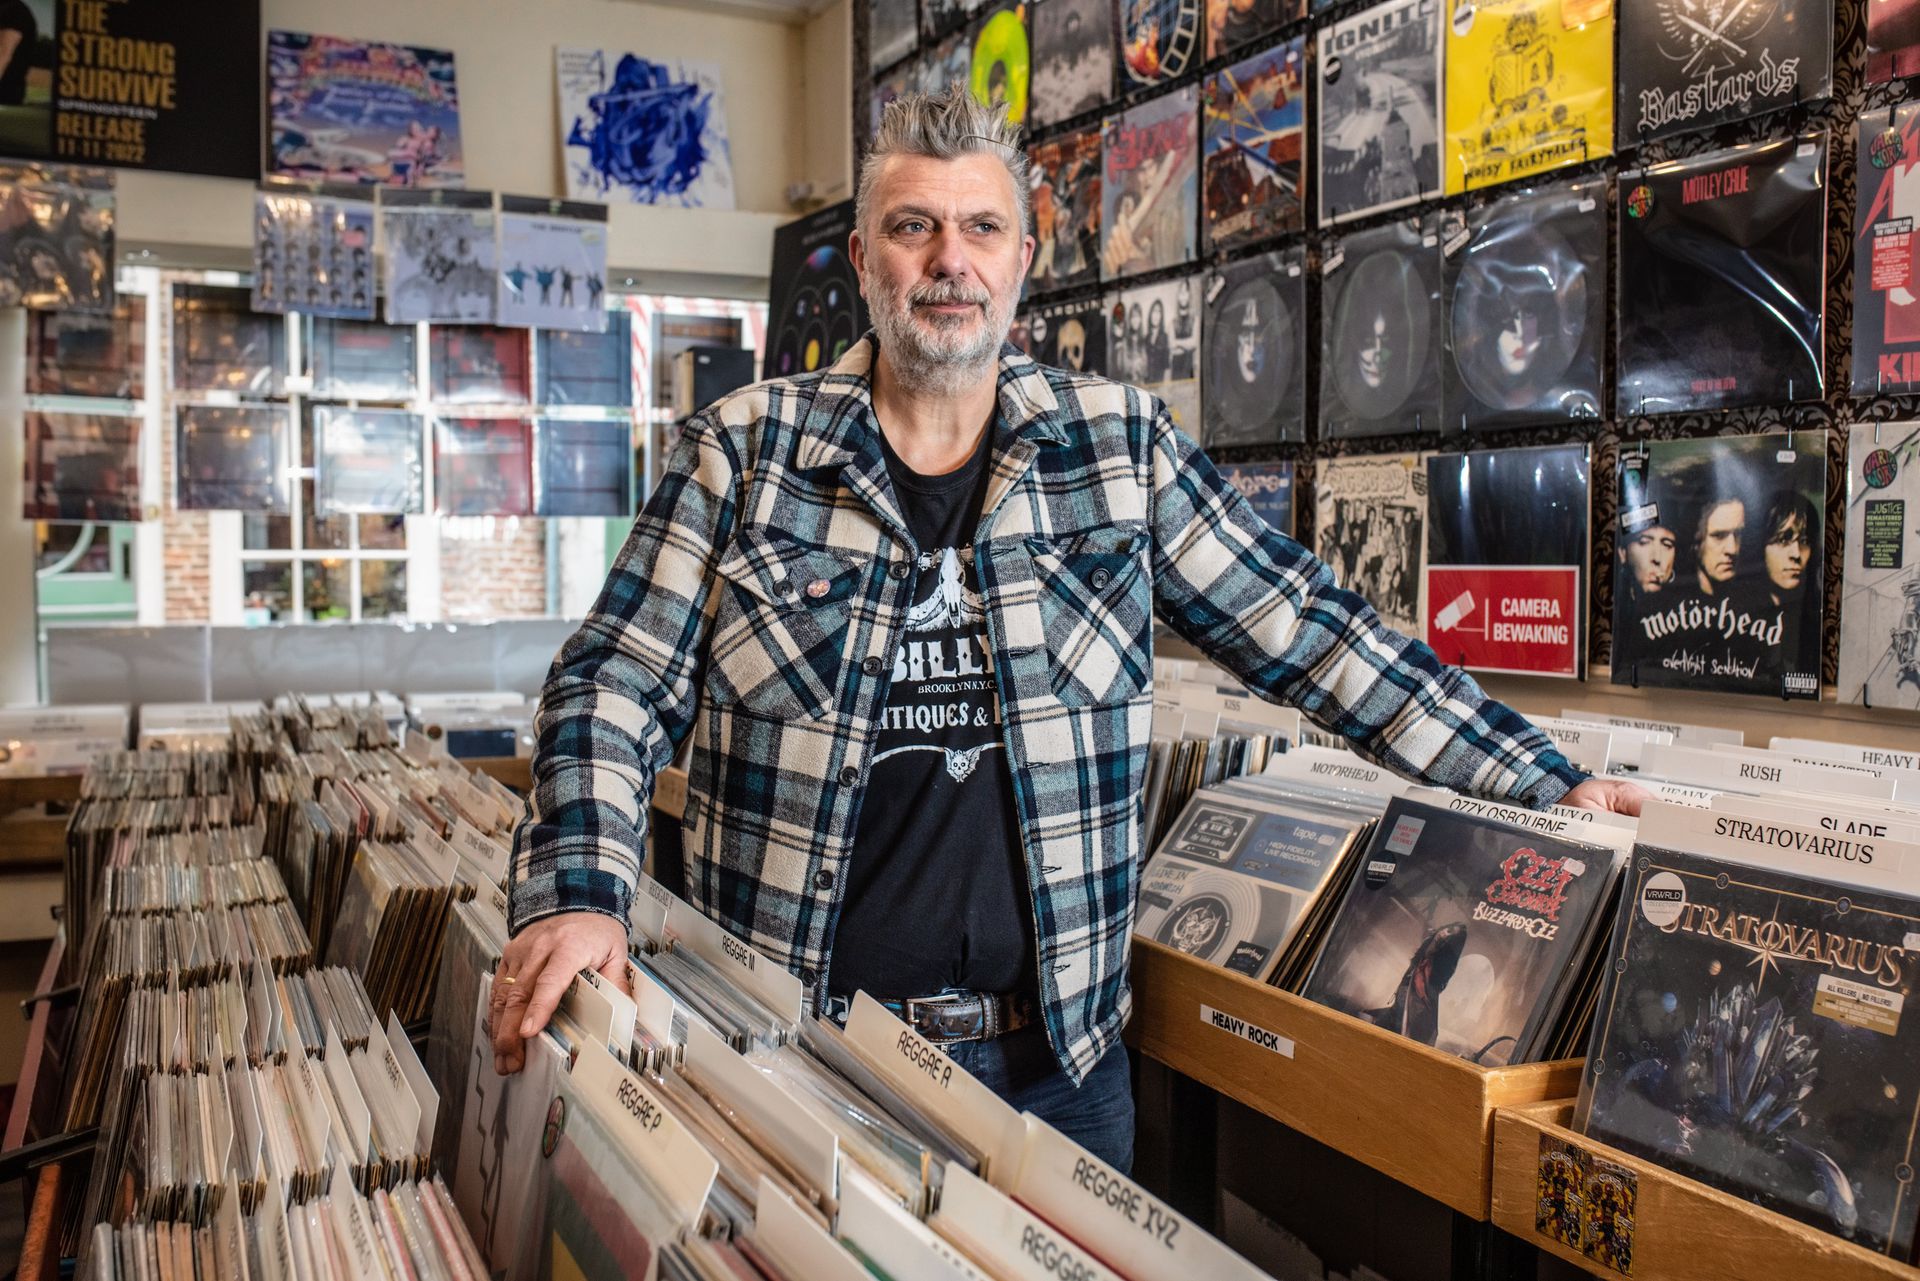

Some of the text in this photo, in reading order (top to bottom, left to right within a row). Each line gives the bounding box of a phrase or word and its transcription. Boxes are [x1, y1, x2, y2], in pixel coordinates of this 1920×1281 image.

[66, 2, 107, 32] THE
[61, 31, 175, 75] STRONG
[59, 66, 176, 109] SURVIVE
[1637, 47, 1800, 132] Bastards
[57, 113, 145, 142] RELEASE
[1501, 598, 1561, 619] CAMERA
[1640, 597, 1784, 646] motörhead
[1493, 623, 1568, 645] BEWAKING
[917, 680, 972, 694] BROOKLYN
[973, 706, 989, 727] &
[1224, 701, 1241, 711] KISS
[1739, 763, 1782, 782] RUSH
[1862, 751, 1913, 769] HEAVY
[1449, 798, 1568, 833] OZZY OSBOURNE
[1714, 817, 1874, 864] STRATOVARIUS
[1646, 889, 1682, 901] VRWRLD
[722, 935, 756, 973] REGGAE M
[1660, 902, 1905, 987] TRATOVARIUS
[1212, 1010, 1279, 1051] HEAVY ROCK
[897, 1030, 952, 1089] REGGAE R
[616, 1078, 662, 1133] REGGAE P
[1072, 1157, 1180, 1250] REGGAE XYZ
